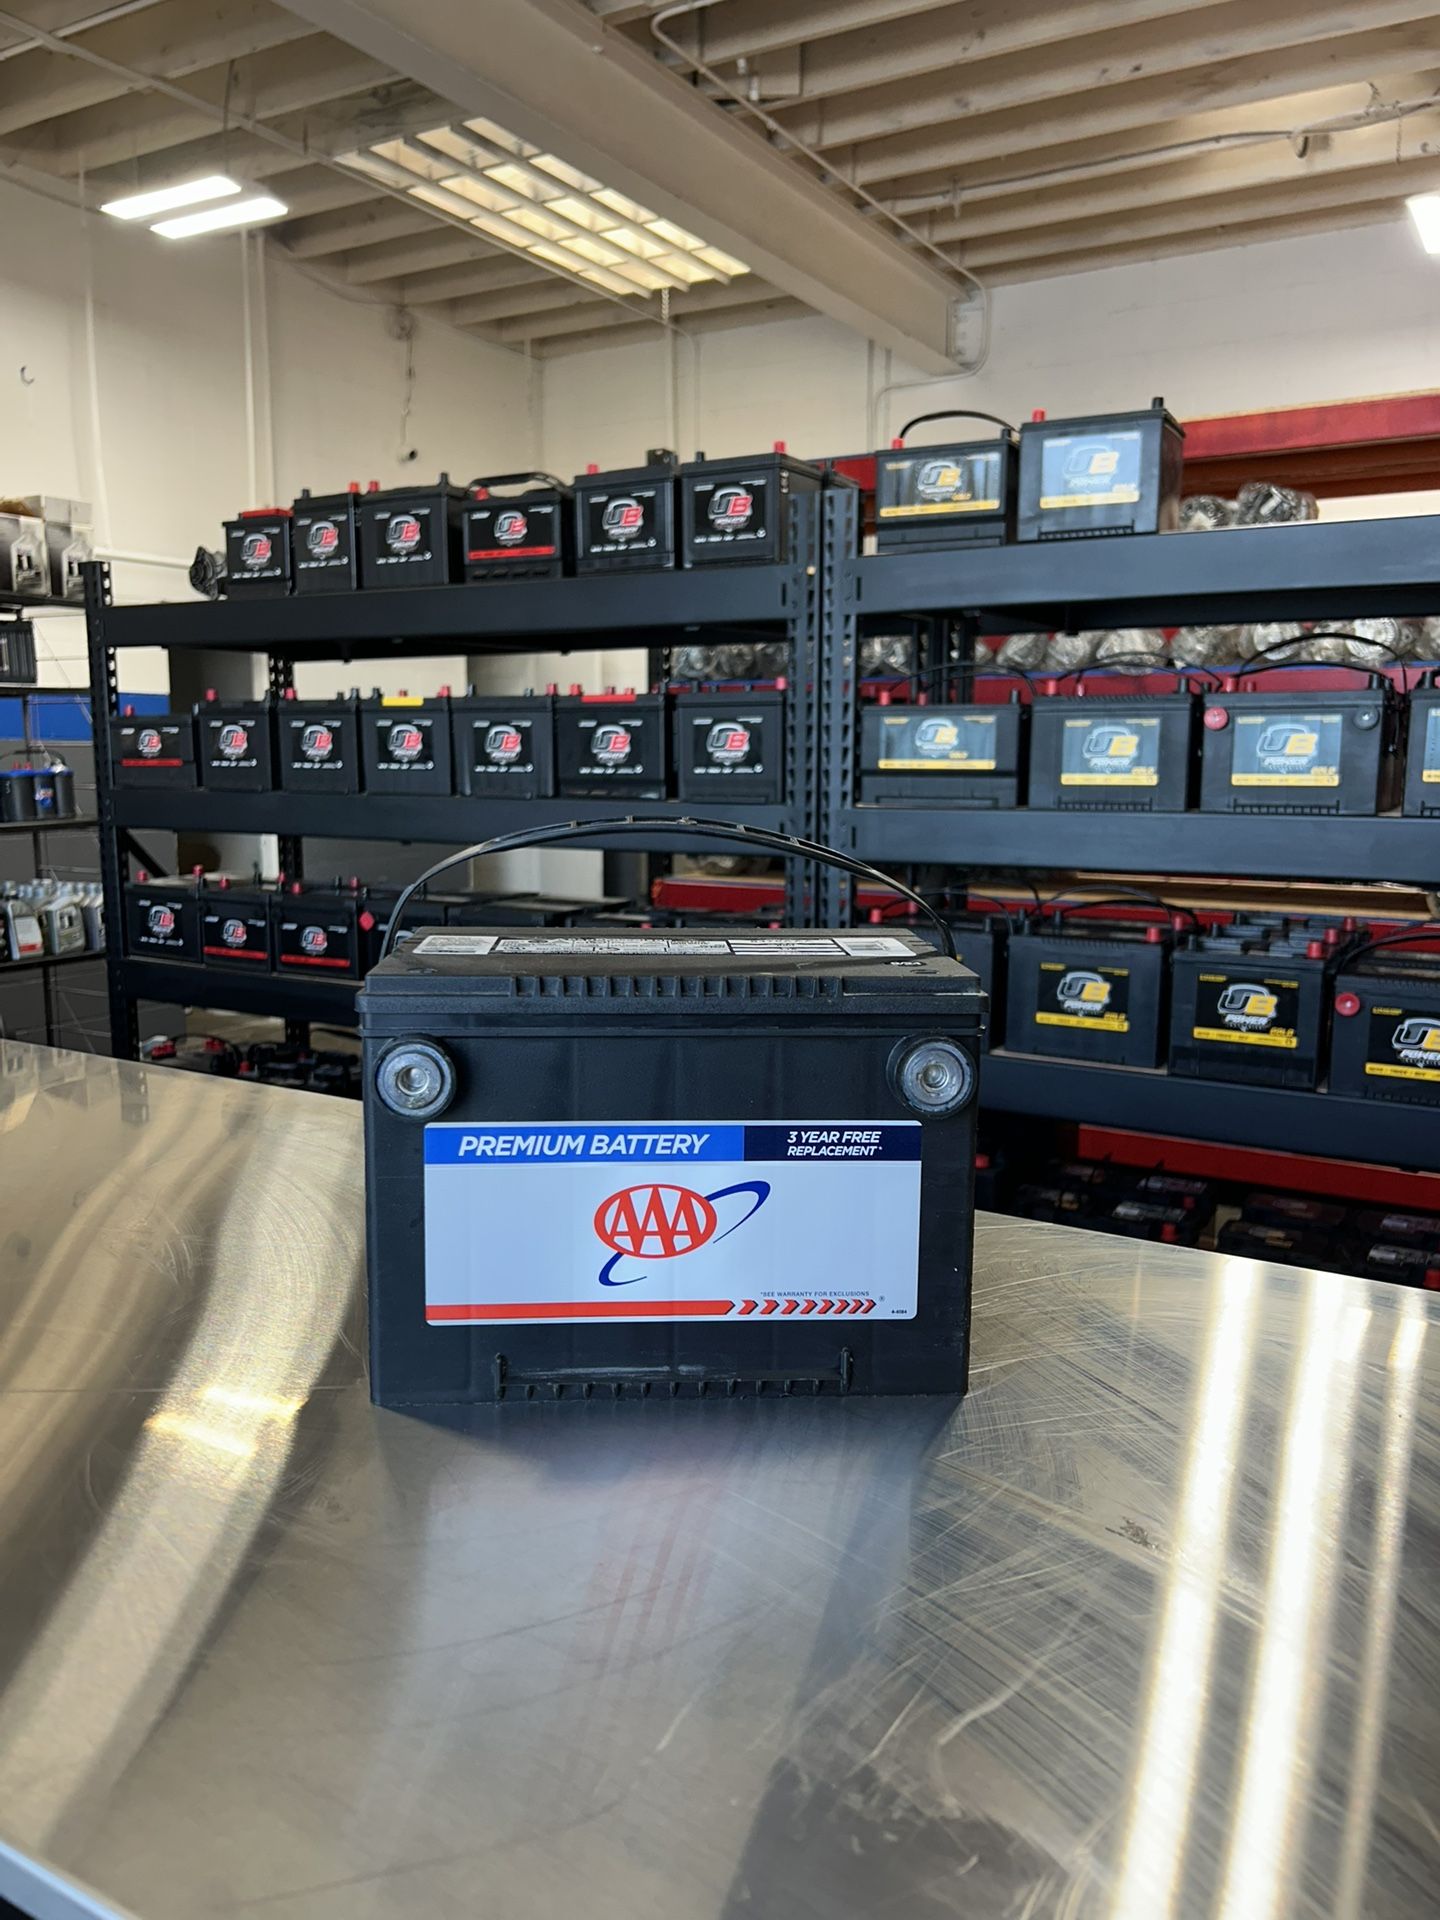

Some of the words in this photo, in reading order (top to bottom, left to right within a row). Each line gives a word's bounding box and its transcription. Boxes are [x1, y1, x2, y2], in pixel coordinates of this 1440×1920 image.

[1082, 734, 1140, 759] UB
[1256, 732, 1318, 757] UB
[1057, 976, 1111, 1003] UB
[1217, 989, 1278, 1017] UB
[458, 1135, 586, 1156] PREMIUM
[589, 1134, 710, 1155] BATTERY
[787, 1131, 798, 1143] 3
[801, 1131, 840, 1143] YEAR
[842, 1131, 882, 1143] FREE
[603, 1186, 710, 1258] AAA
